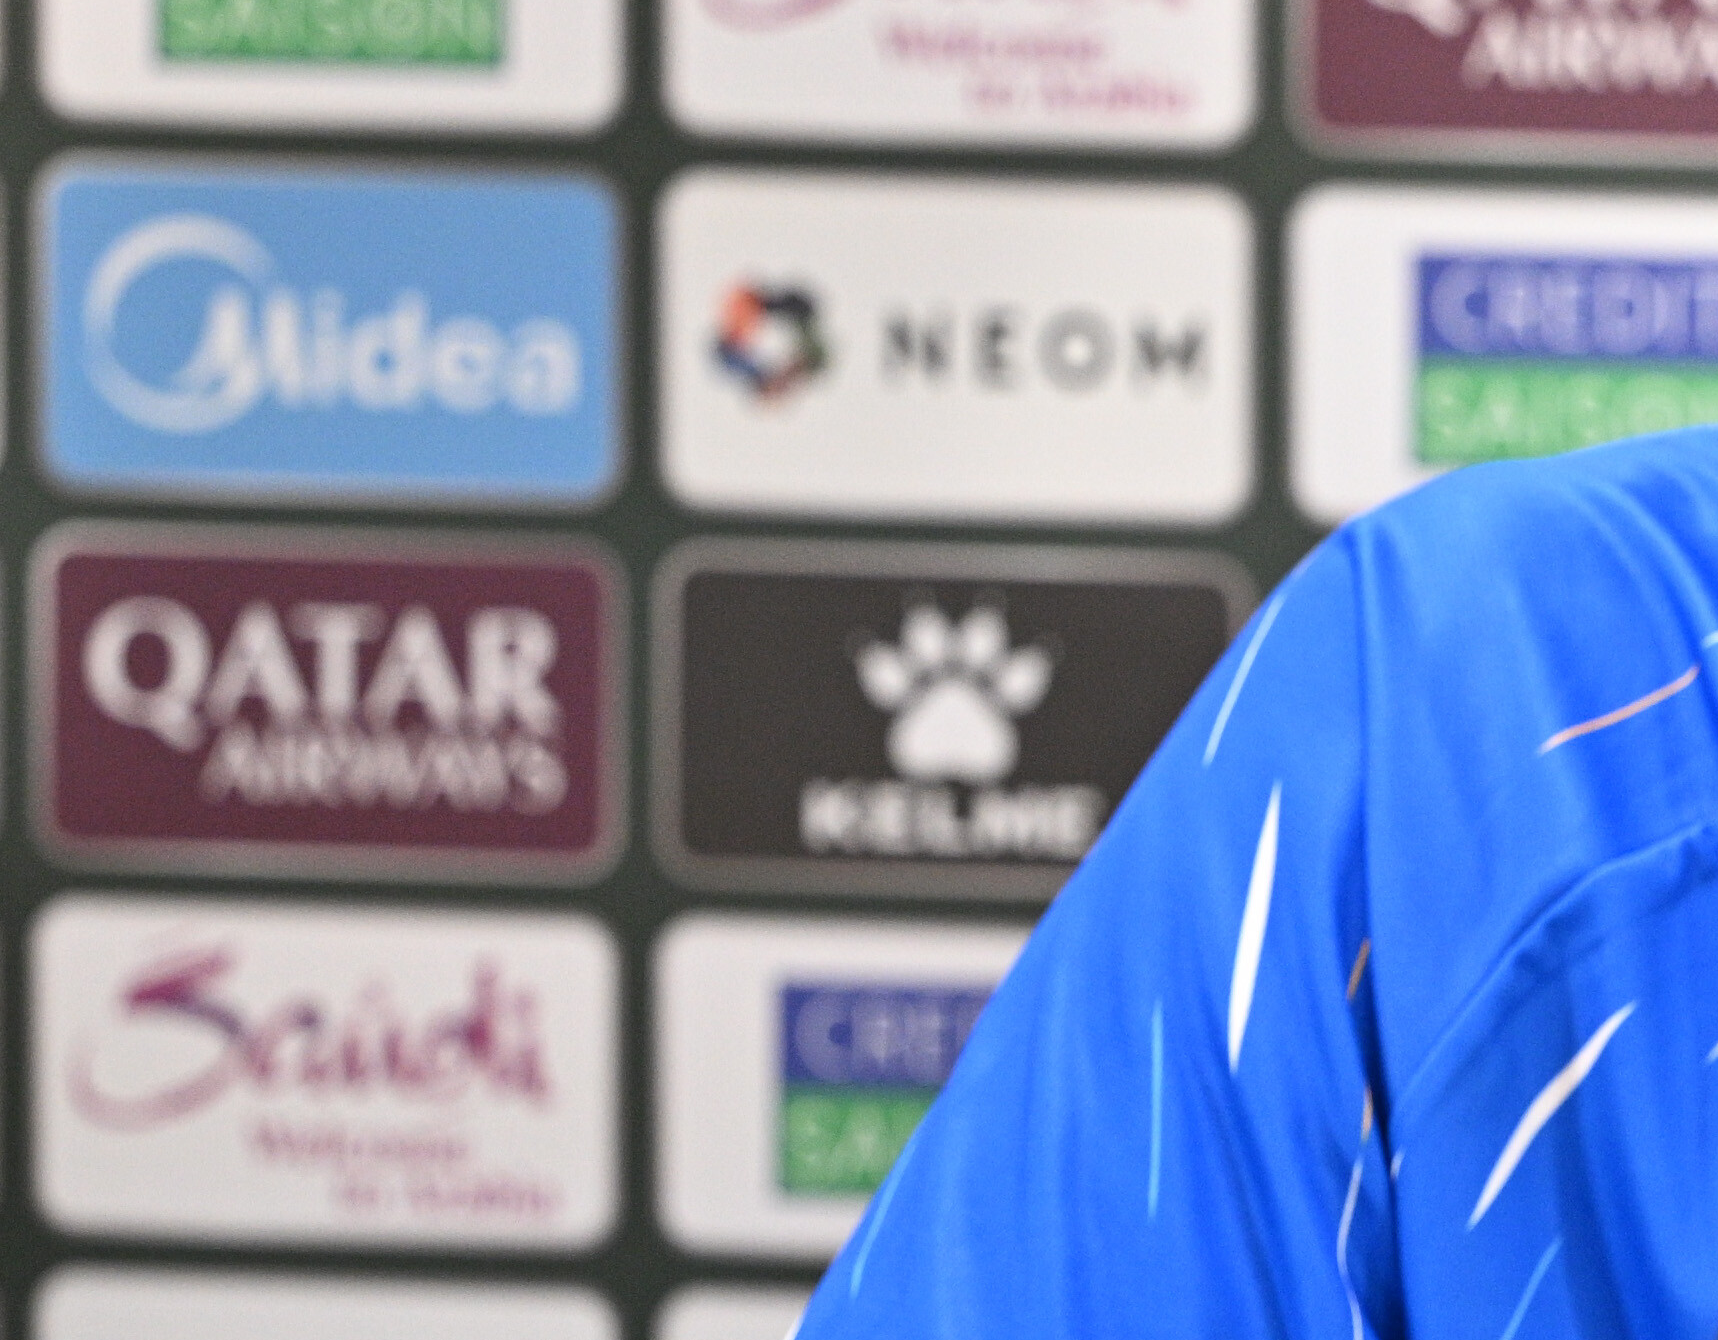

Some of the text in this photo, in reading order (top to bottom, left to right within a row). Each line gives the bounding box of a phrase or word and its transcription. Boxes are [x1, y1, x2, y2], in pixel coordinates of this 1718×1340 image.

[193, 285, 584, 417] Midea
[878, 305, 1208, 391] NEOM
[84, 598, 560, 751] QATAR
[203, 731, 569, 813] AIRWAYS
[802, 778, 1097, 856] KELME
[796, 994, 985, 1080] CRE
